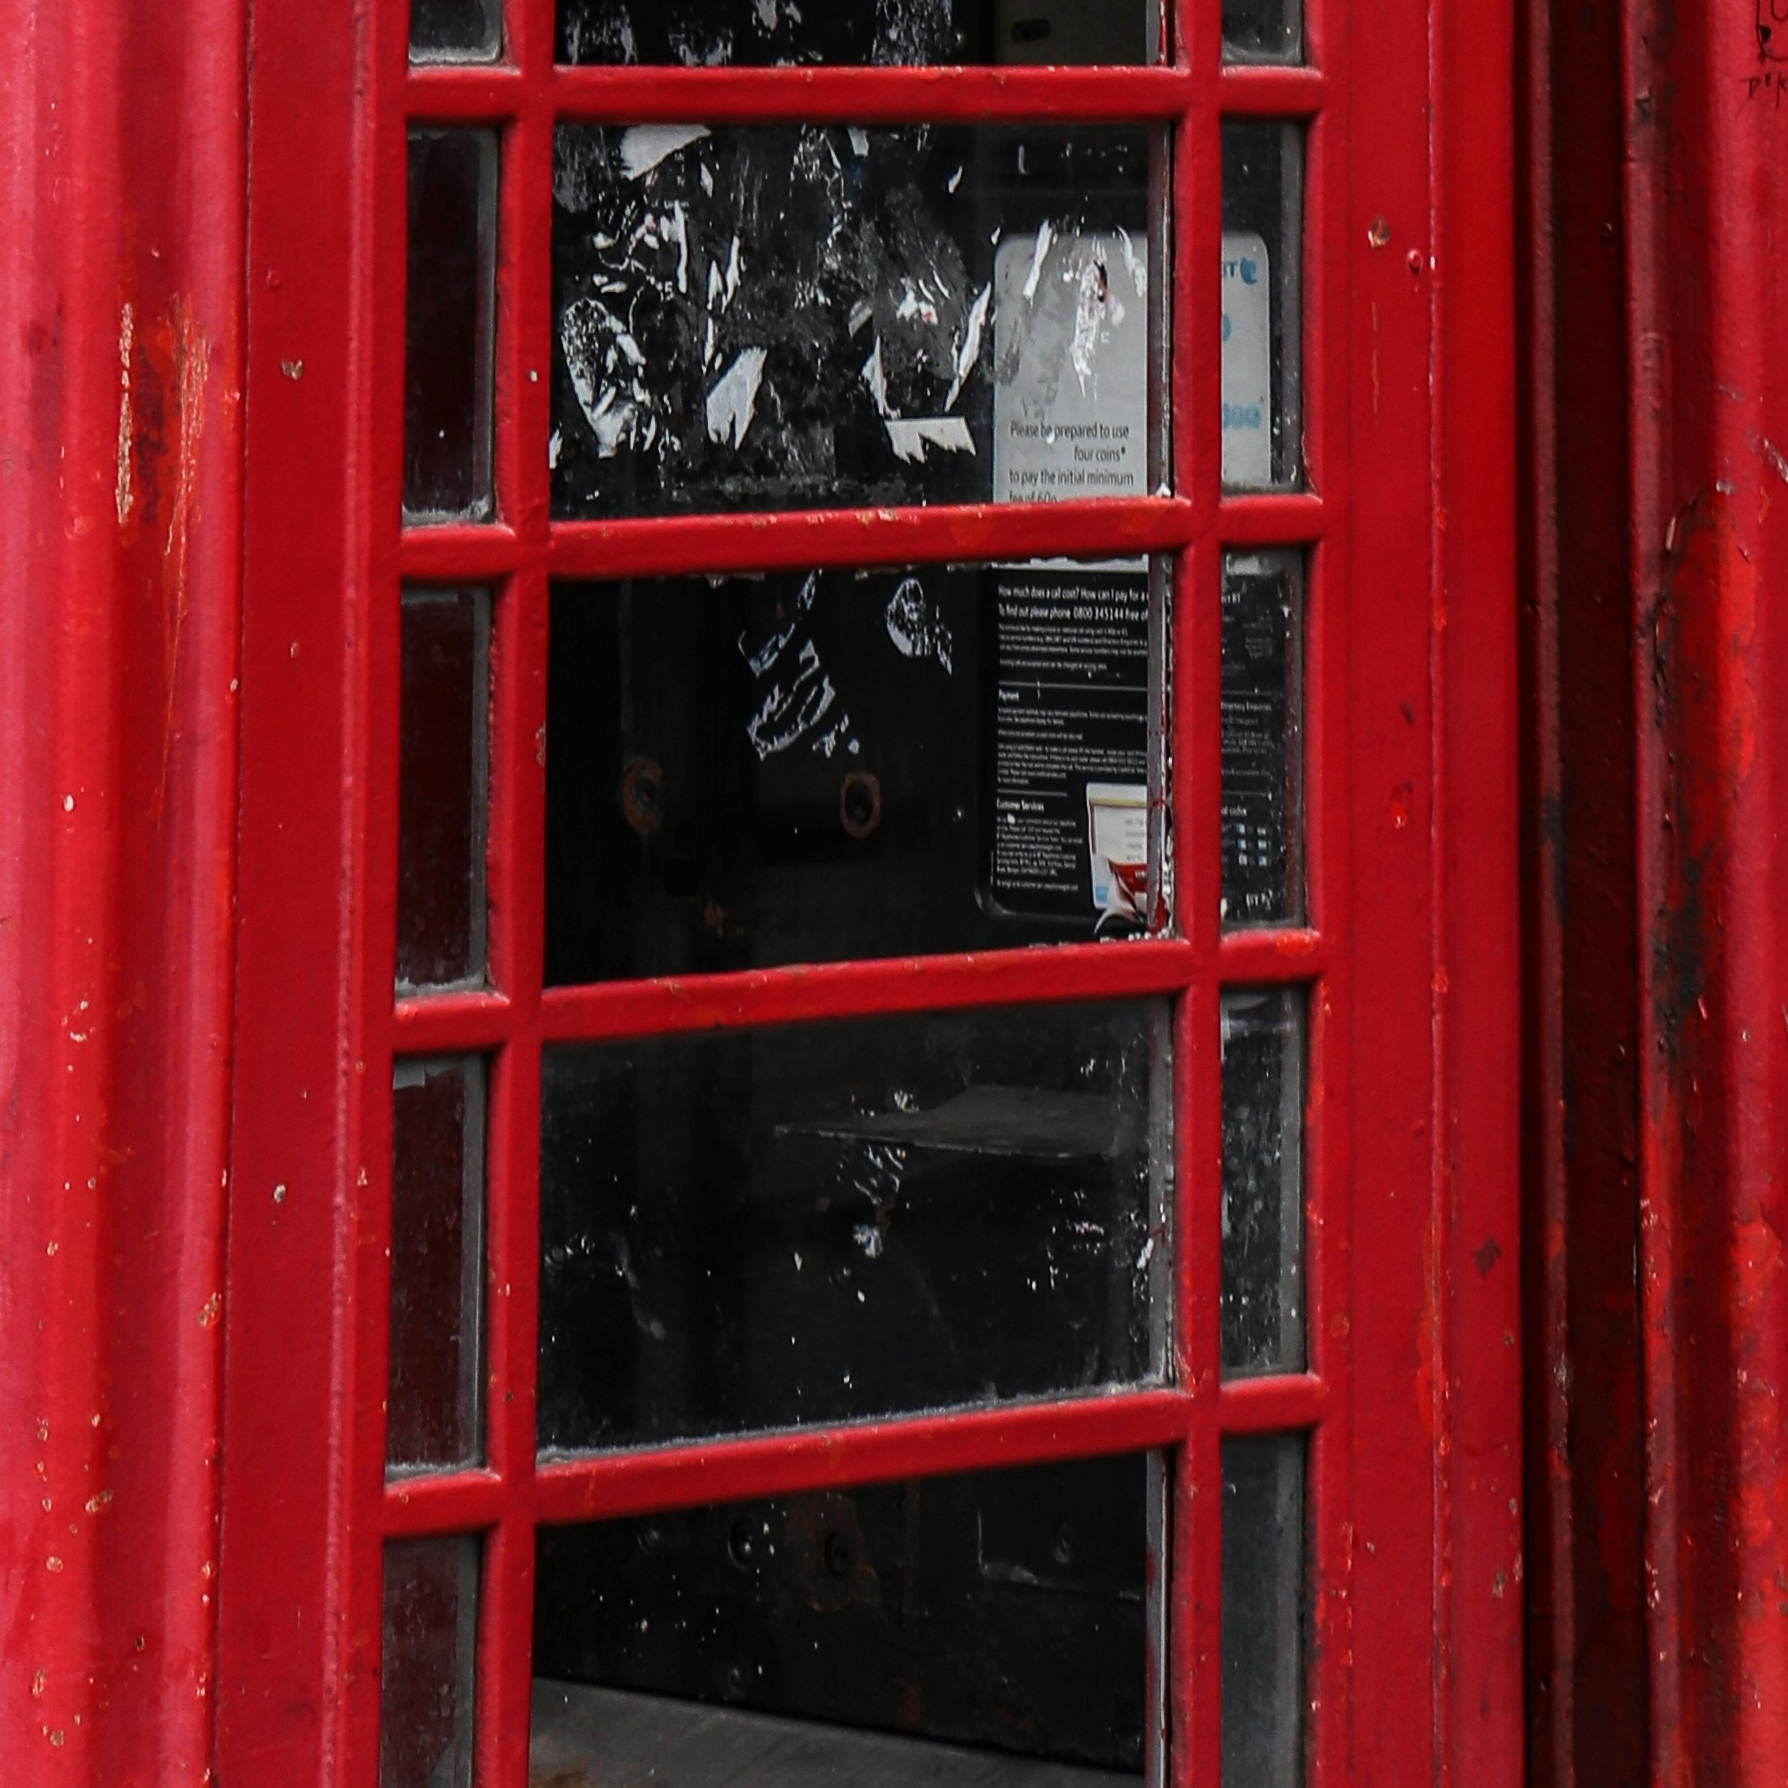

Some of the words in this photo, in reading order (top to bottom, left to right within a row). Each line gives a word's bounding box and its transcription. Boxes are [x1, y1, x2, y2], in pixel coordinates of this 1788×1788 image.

[1010, 421, 1039, 437] Please
[1054, 423, 1098, 441] prepared
[1099, 424, 1110, 438] to
[1112, 426, 1129, 439] use
[1073, 445, 1094, 461] four
[1009, 468, 1019, 483] to
[1021, 471, 1039, 487] pay
[1040, 469, 1056, 484] the
[1057, 469, 1085, 485] initial
[1086, 469, 1134, 486] minimum
